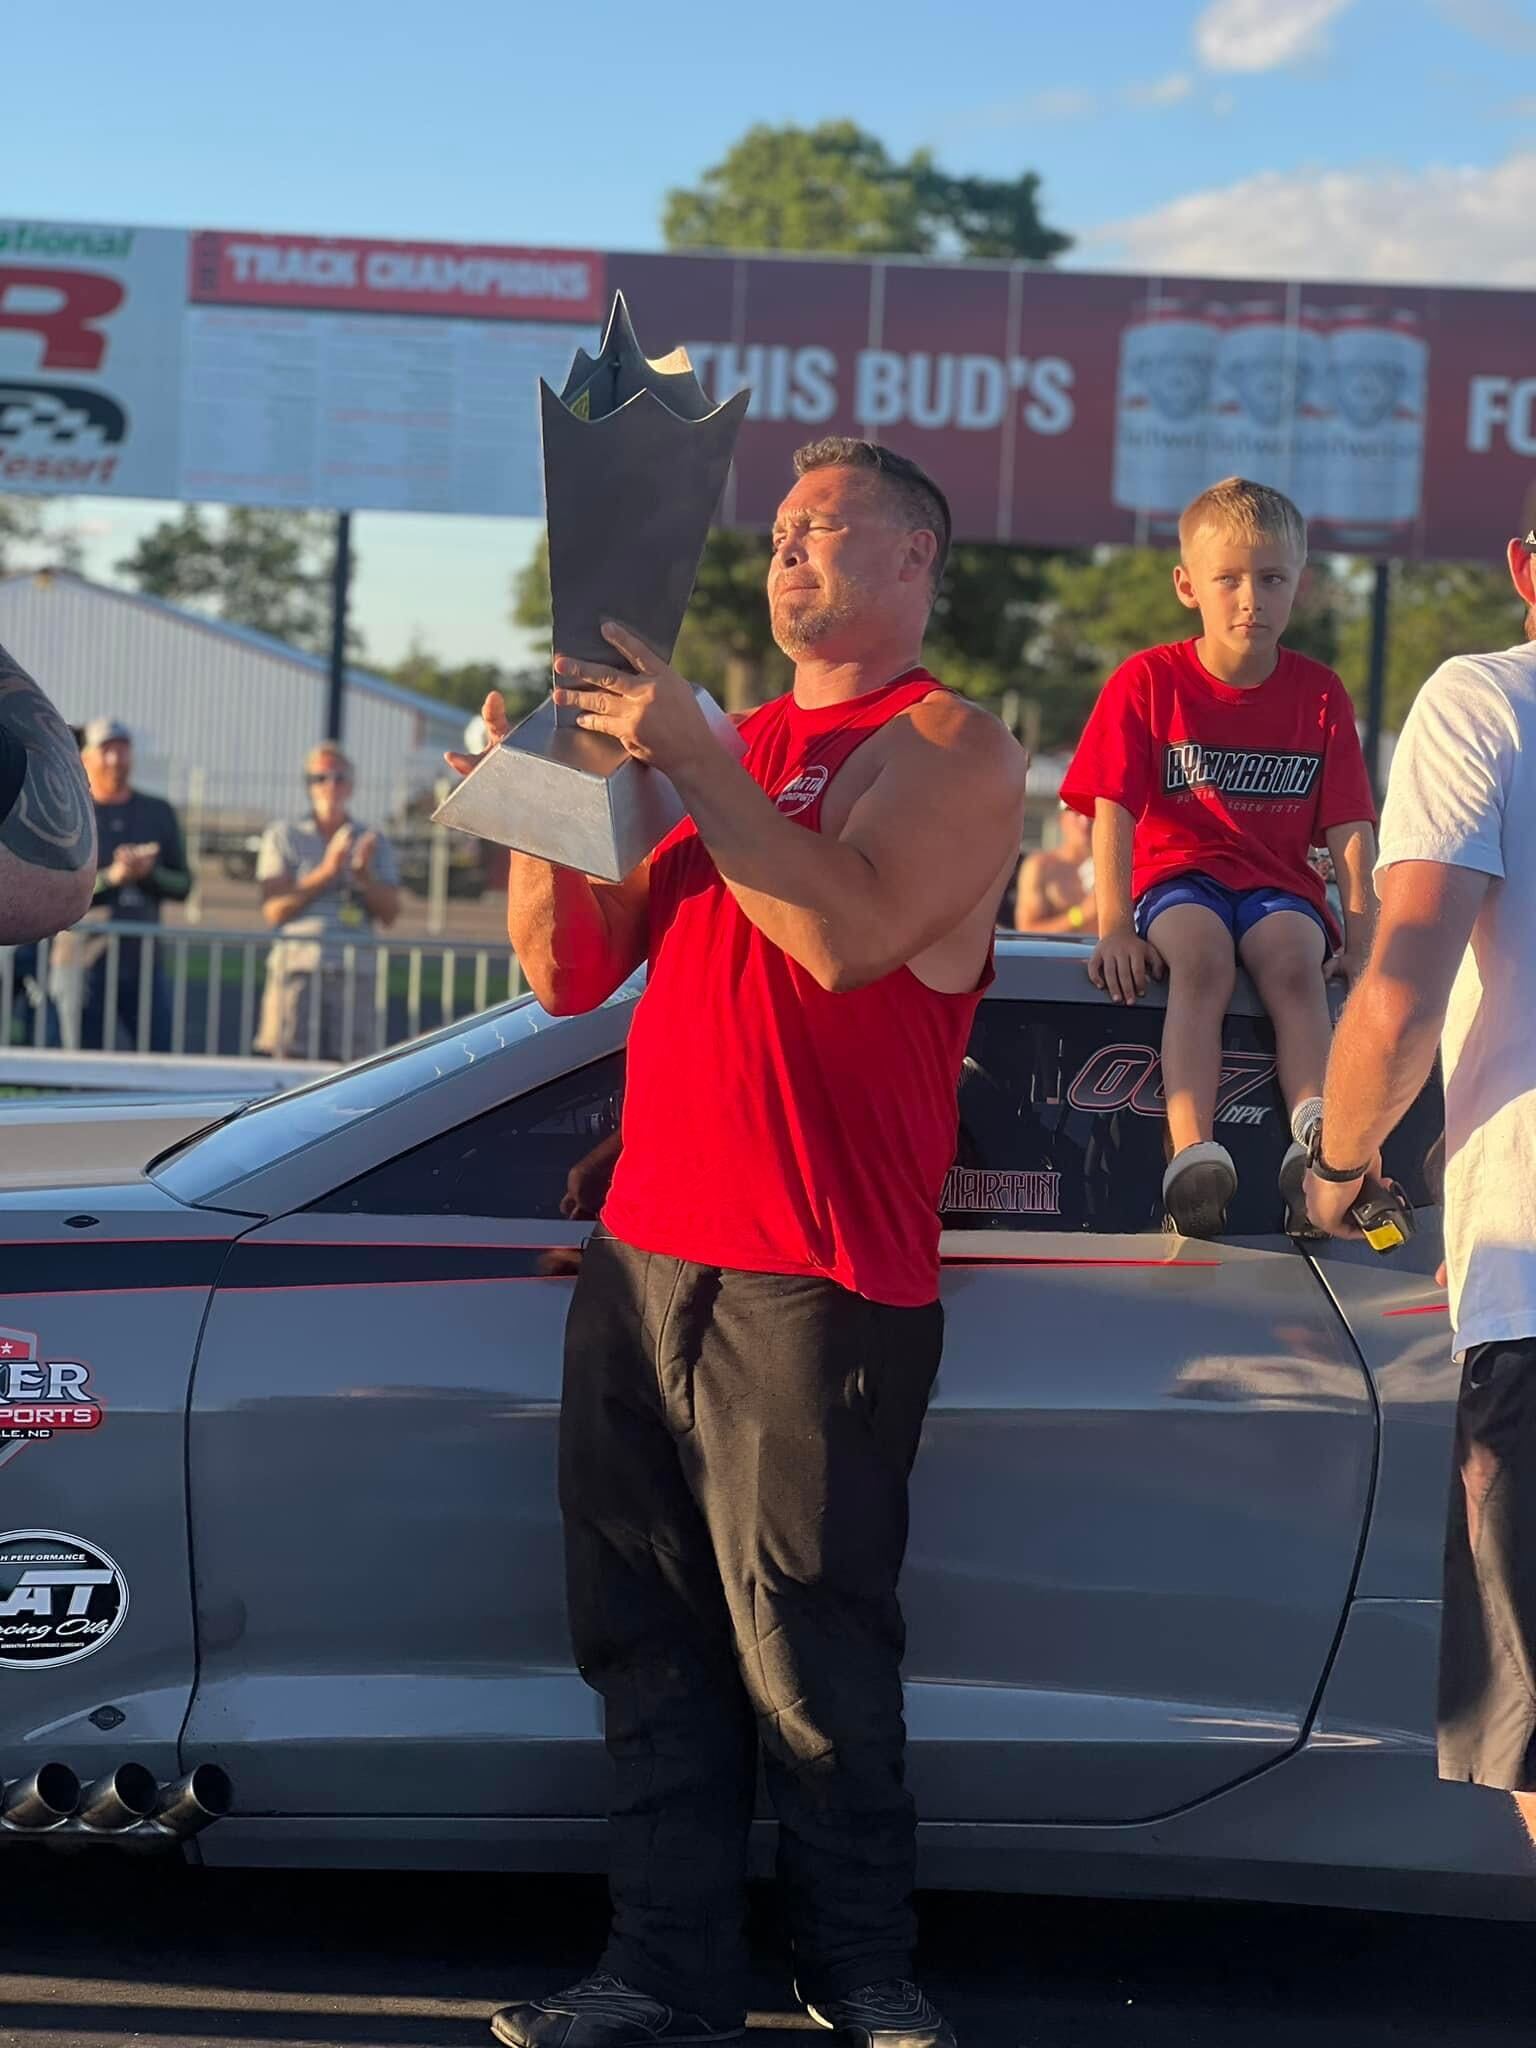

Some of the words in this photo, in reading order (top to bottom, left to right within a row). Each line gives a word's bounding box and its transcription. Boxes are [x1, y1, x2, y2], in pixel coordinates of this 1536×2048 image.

[0, 222, 136, 258] tional
[228, 244, 357, 287] TRACK
[364, 251, 589, 301] CHAMPIONS
[682, 341, 838, 423] THIS
[854, 350, 1073, 435] BUD'S
[0, 449, 120, 485] esort
[1217, 752, 1320, 794] MARTIN
[0, 1363, 93, 1404] ER
[56, 1618, 109, 1637] Oils
